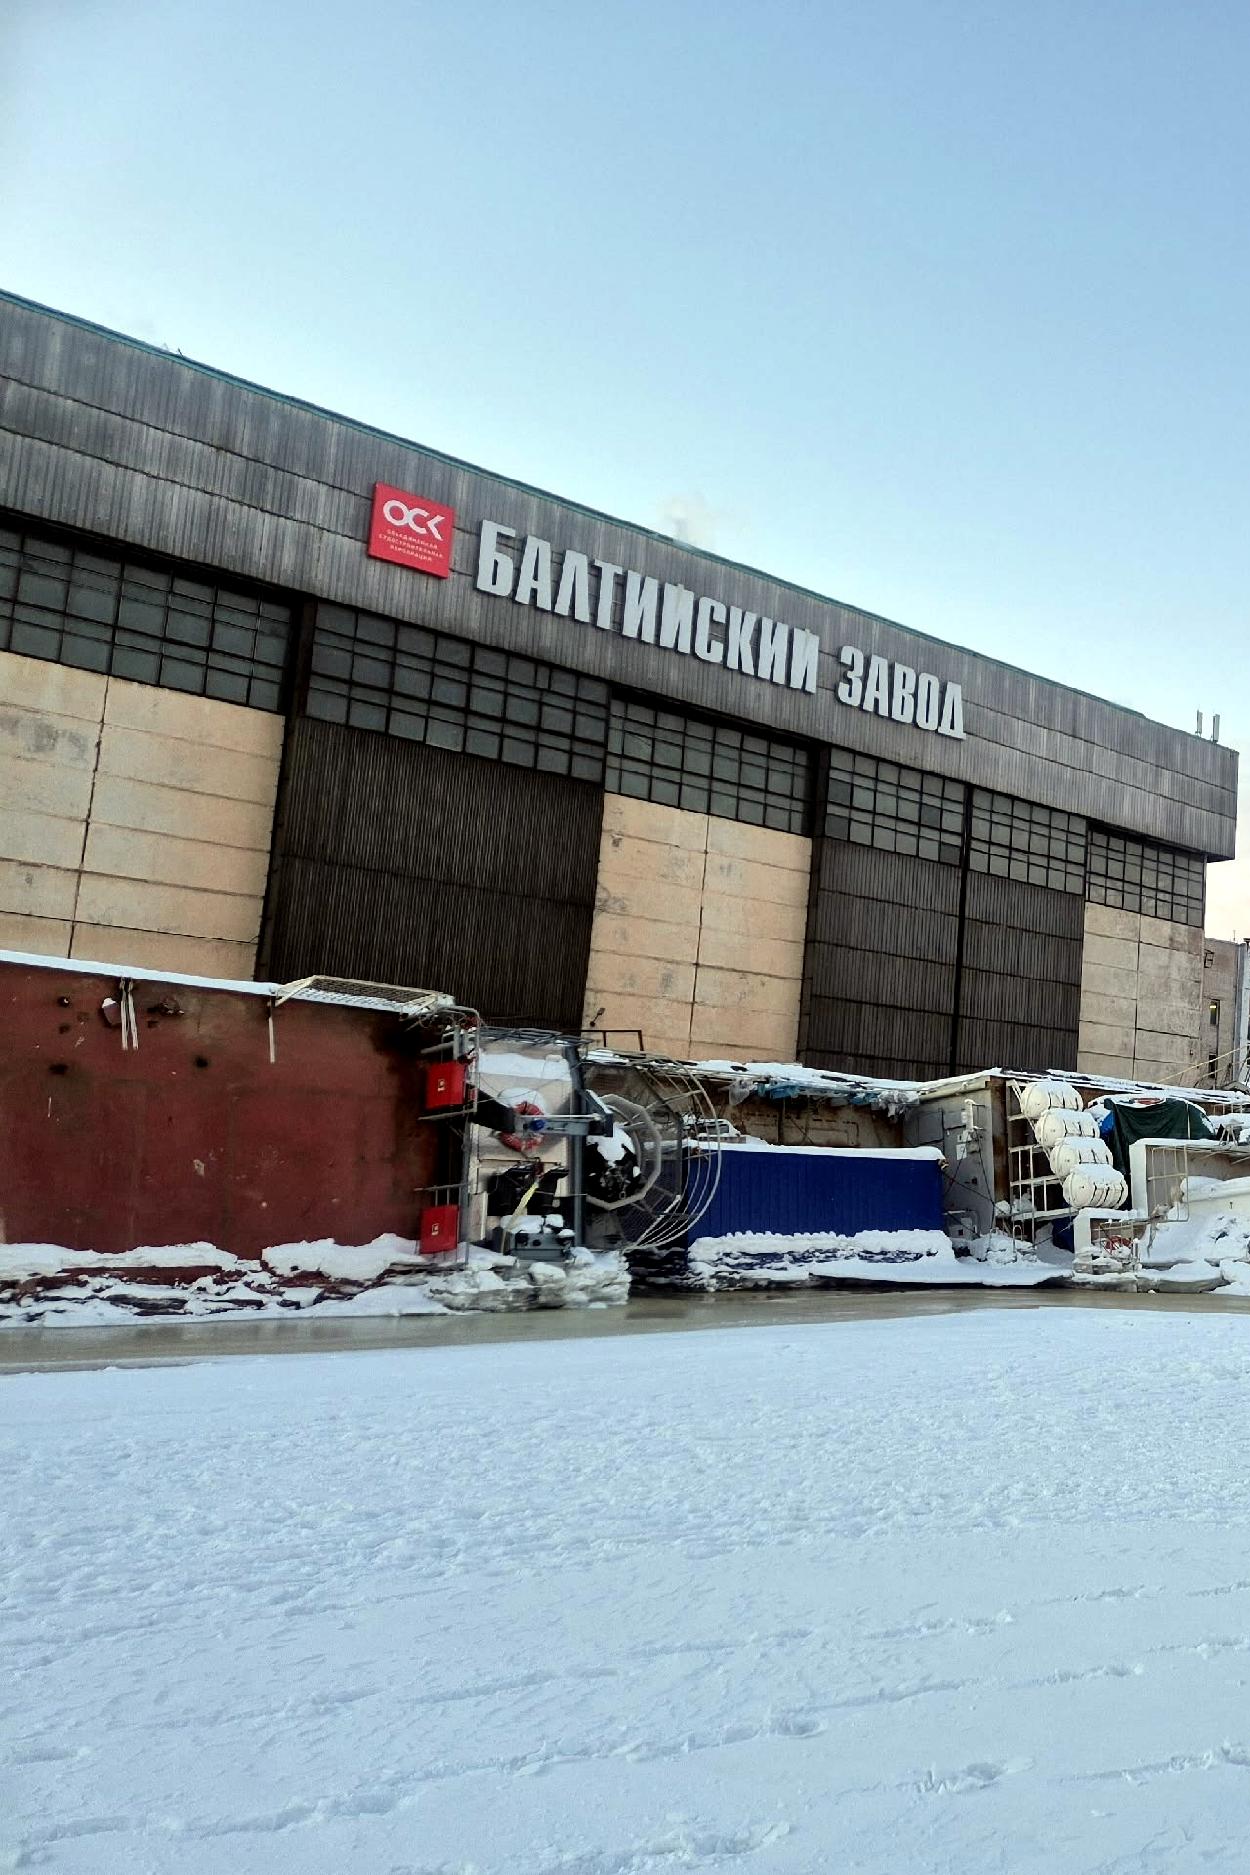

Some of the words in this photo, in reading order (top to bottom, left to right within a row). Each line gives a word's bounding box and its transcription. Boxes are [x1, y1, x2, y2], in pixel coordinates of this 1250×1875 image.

[383, 500, 445, 541] ОСК
[476, 520, 819, 693] БАЛТИЙСКИЙ
[838, 646, 966, 740] ЗАВОД
